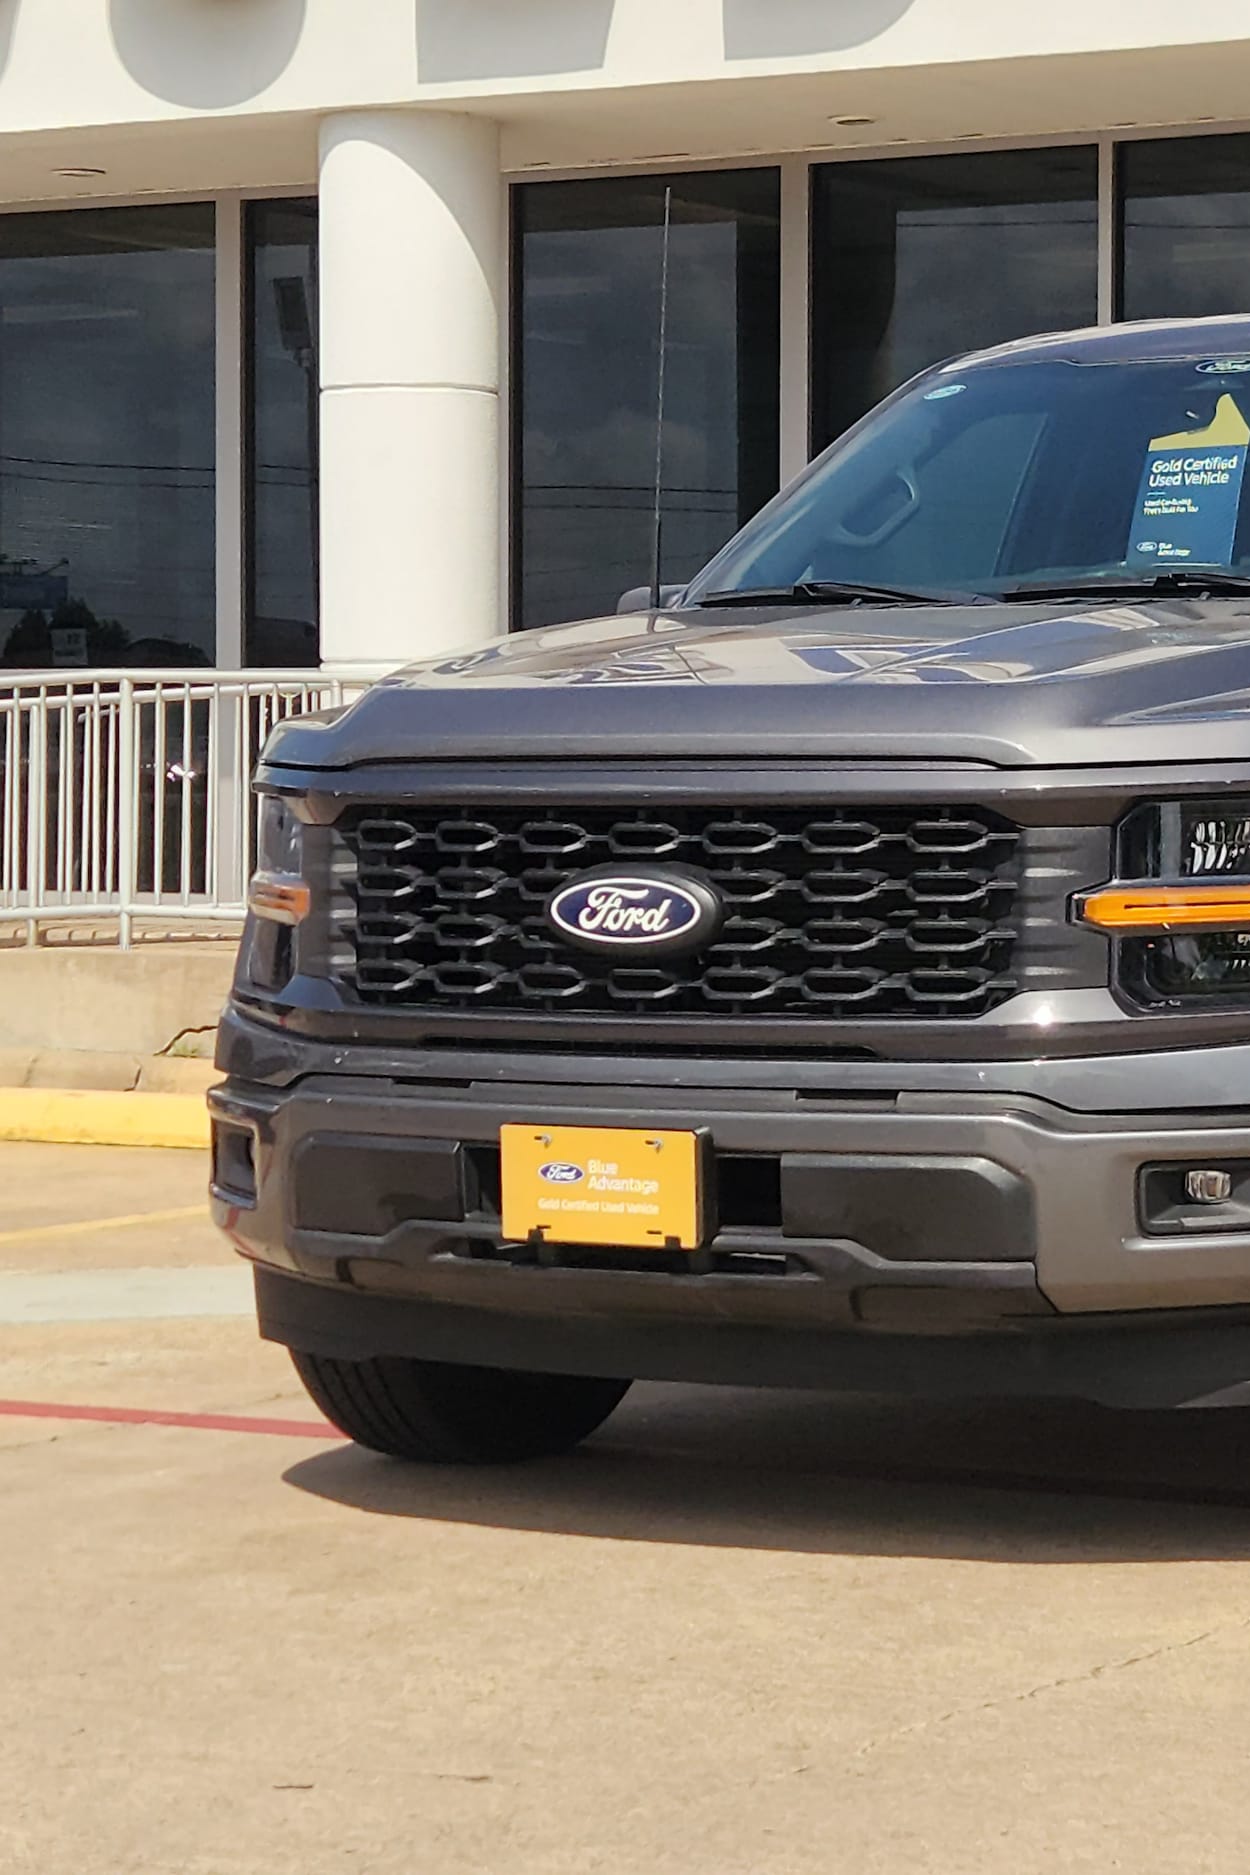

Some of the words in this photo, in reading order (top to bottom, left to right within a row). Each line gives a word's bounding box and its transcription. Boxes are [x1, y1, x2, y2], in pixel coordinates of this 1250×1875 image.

[1152, 458, 1183, 473] Gold
[1183, 455, 1238, 471] Certified
[1149, 473, 1182, 487] Used
[1184, 471, 1230, 485] Vehicle
[578, 886, 673, 932] Ford
[587, 1159, 618, 1175] Blue
[587, 1175, 659, 1195] Advantage
[538, 1198, 560, 1210] Gold
[601, 1201, 624, 1213] Used
[626, 1203, 659, 1215] Vehicle
